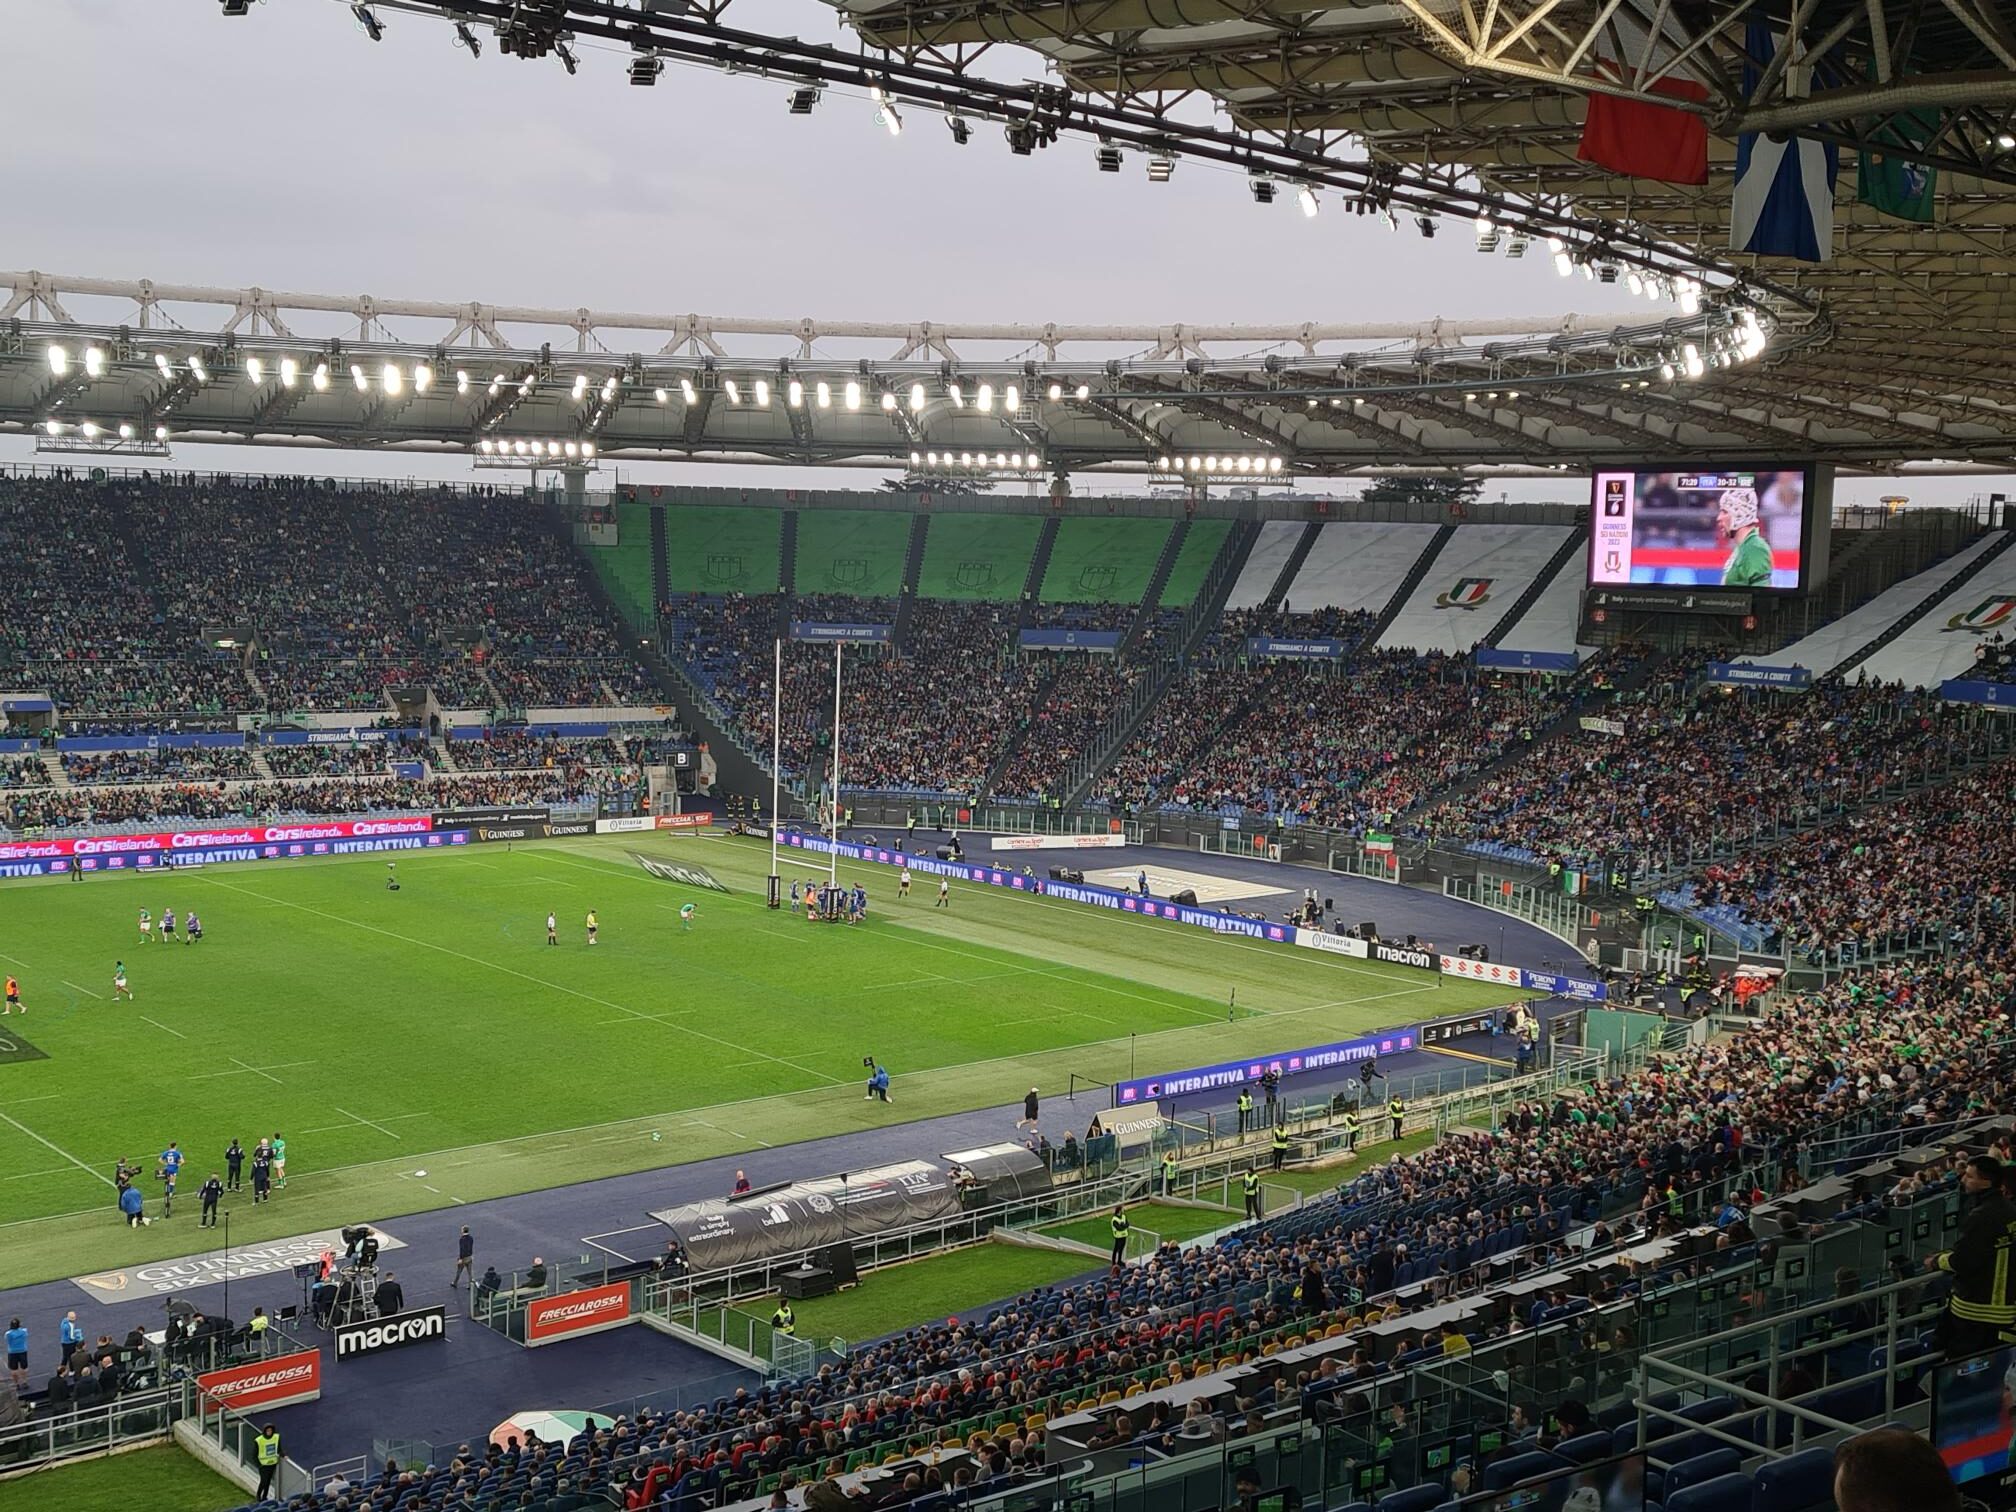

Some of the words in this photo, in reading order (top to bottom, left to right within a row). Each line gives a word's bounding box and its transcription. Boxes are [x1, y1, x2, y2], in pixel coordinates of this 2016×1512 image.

[677, 753, 687, 764] B
[552, 825, 588, 836] GUINNESS
[334, 837, 422, 854] INTERATTIVA
[160, 849, 258, 866] ITERATTIVA
[907, 857, 970, 880] INTERATTIVA
[1047, 883, 1119, 909] INTERATTIVA
[1181, 910, 1264, 938] INTERATTIVA
[1321, 934, 1351, 948] Vittoria
[1377, 945, 1430, 968] macron
[1529, 971, 1556, 985] PERONI
[1568, 979, 1597, 992] PERONI
[1305, 1044, 1377, 1069] INTERATTIVA
[1165, 1069, 1245, 1095] INTERATTIVA
[1115, 1118, 1161, 1135] GUINNESS
[136, 1239, 332, 1282] GUINNESS
[153, 1275, 208, 1292] SIX
[538, 1294, 624, 1322] FRECCIAROSSA
[338, 1314, 443, 1355] macron
[207, 1363, 313, 1397] FRECCIAROSSA
